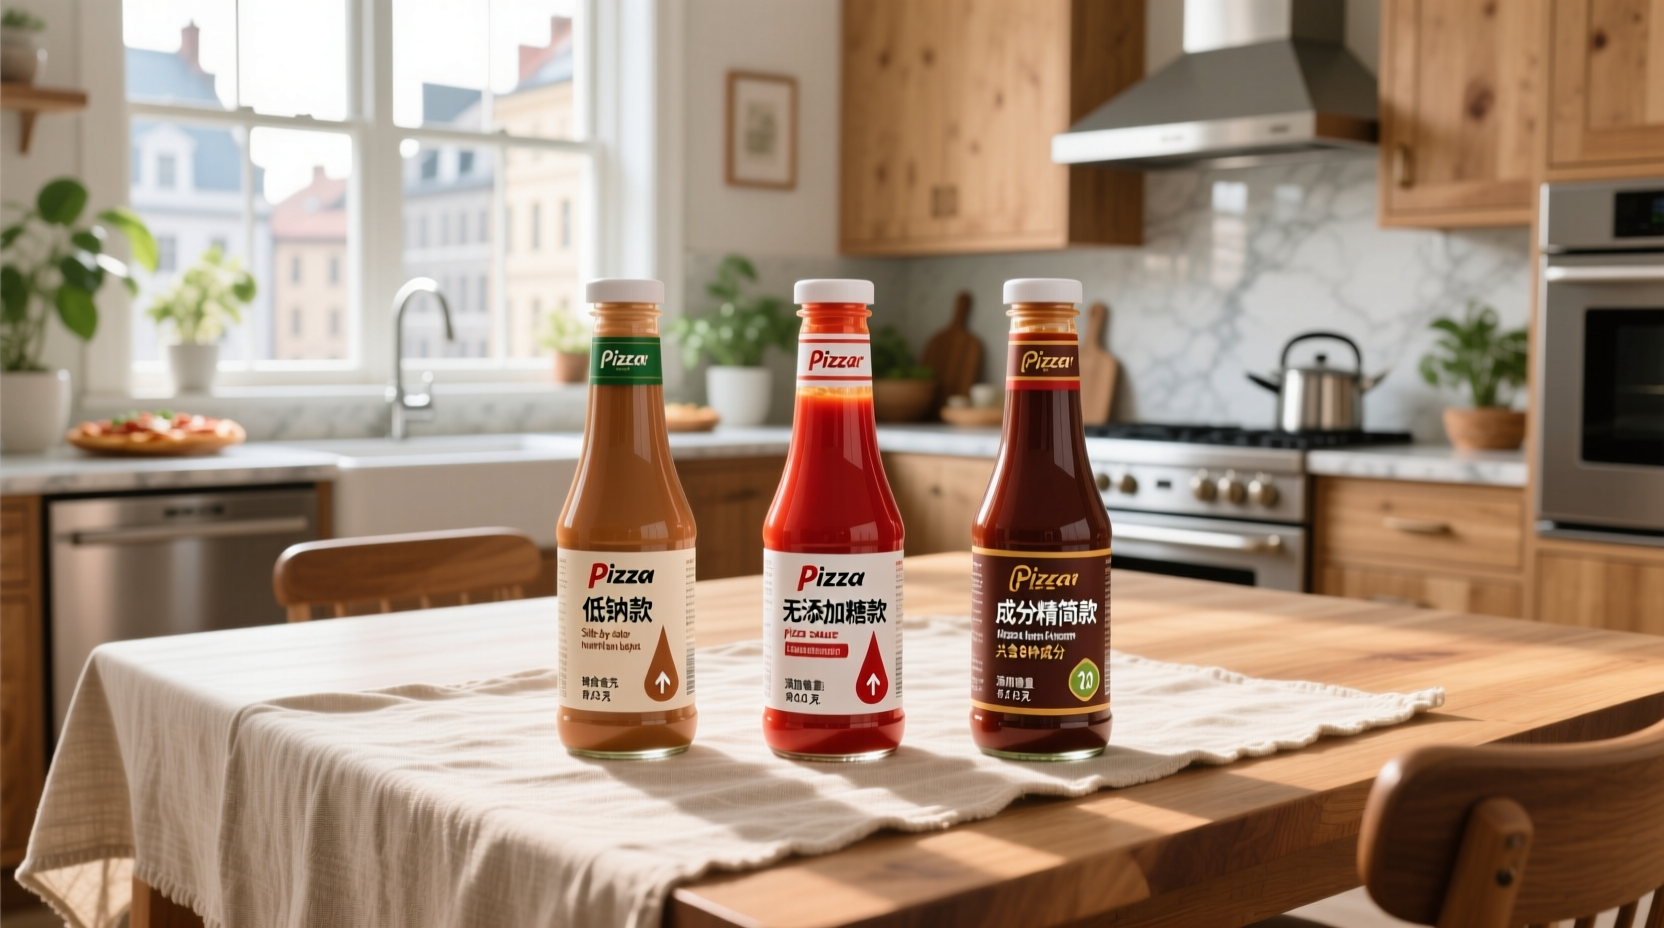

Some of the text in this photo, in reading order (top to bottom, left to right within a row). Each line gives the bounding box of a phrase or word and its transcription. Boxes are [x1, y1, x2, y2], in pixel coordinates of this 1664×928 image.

[588, 563, 655, 589] Pizza
[797, 564, 865, 591] Pizza
[582, 596, 653, 623] 低钠款
[783, 598, 887, 625] 无添加糖款
[995, 599, 1098, 627] 成分精简款
